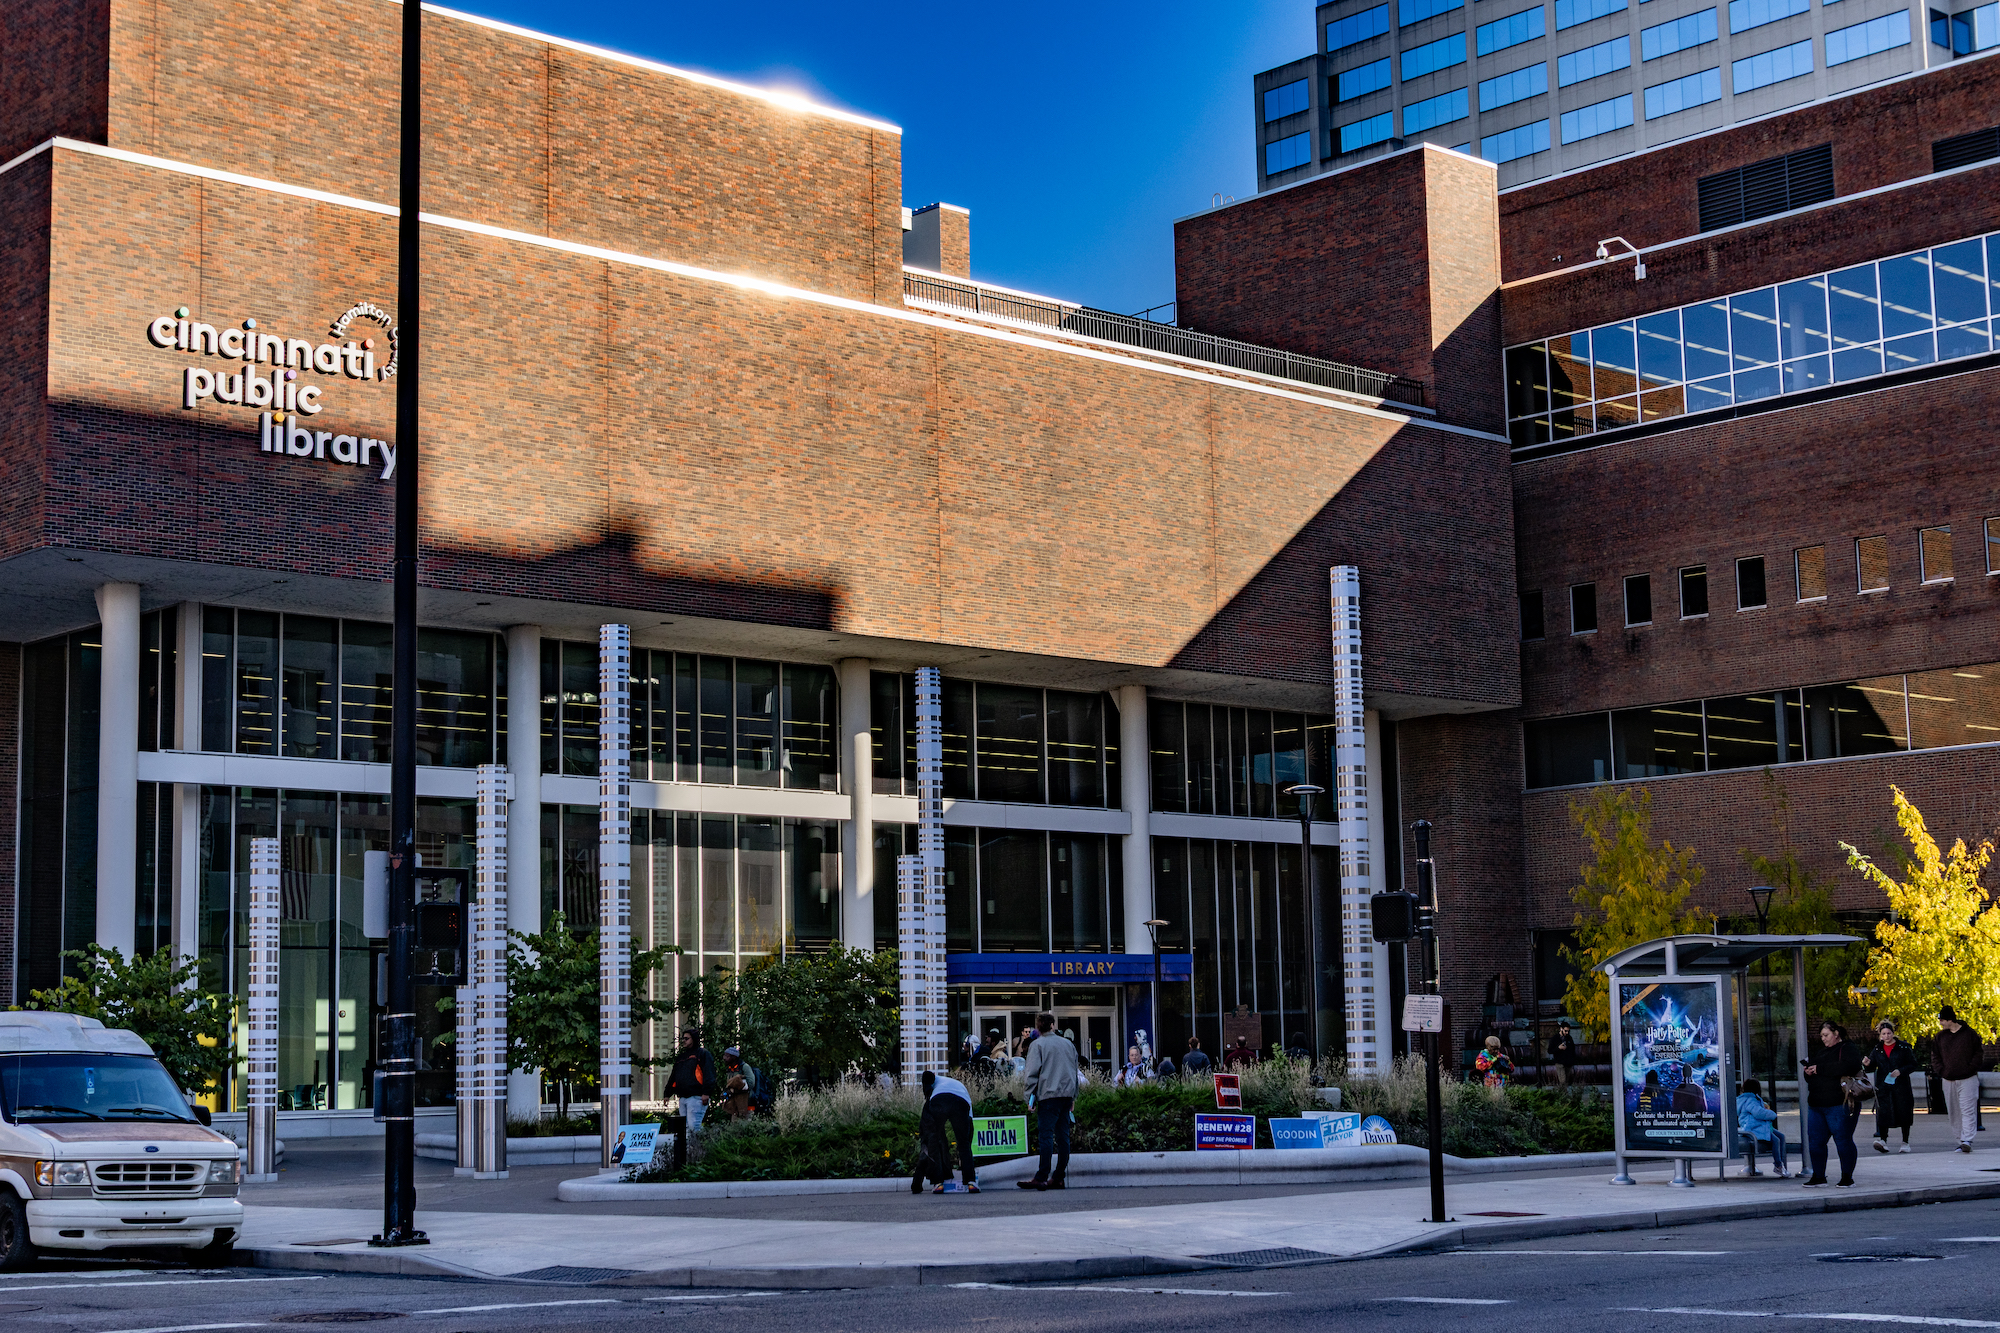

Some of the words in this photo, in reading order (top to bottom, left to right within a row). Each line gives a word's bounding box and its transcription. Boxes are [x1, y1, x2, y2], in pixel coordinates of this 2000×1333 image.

[333, 302, 392, 337] Hamilton
[150, 306, 374, 379] cincinnati
[186, 363, 323, 414] public
[261, 411, 397, 480] library
[1050, 961, 1115, 975] LIBRARY
[1646, 1026, 1667, 1042] Harry
[1667, 1024, 1689, 1041] Potter
[1666, 1111, 1680, 1120] Harry
[987, 1119, 1005, 1129] EVAN
[1197, 1123, 1233, 1132] RENEW
[1234, 1124, 1252, 1133] #28
[1321, 1117, 1353, 1134] FTAB
[1679, 1119, 1702, 1129] nighttime
[977, 1129, 1017, 1146] NOLAN
[1277, 1130, 1317, 1139] GOODIN
[1328, 1131, 1354, 1143] MAYOR
[1365, 1132, 1393, 1144] Dawn
